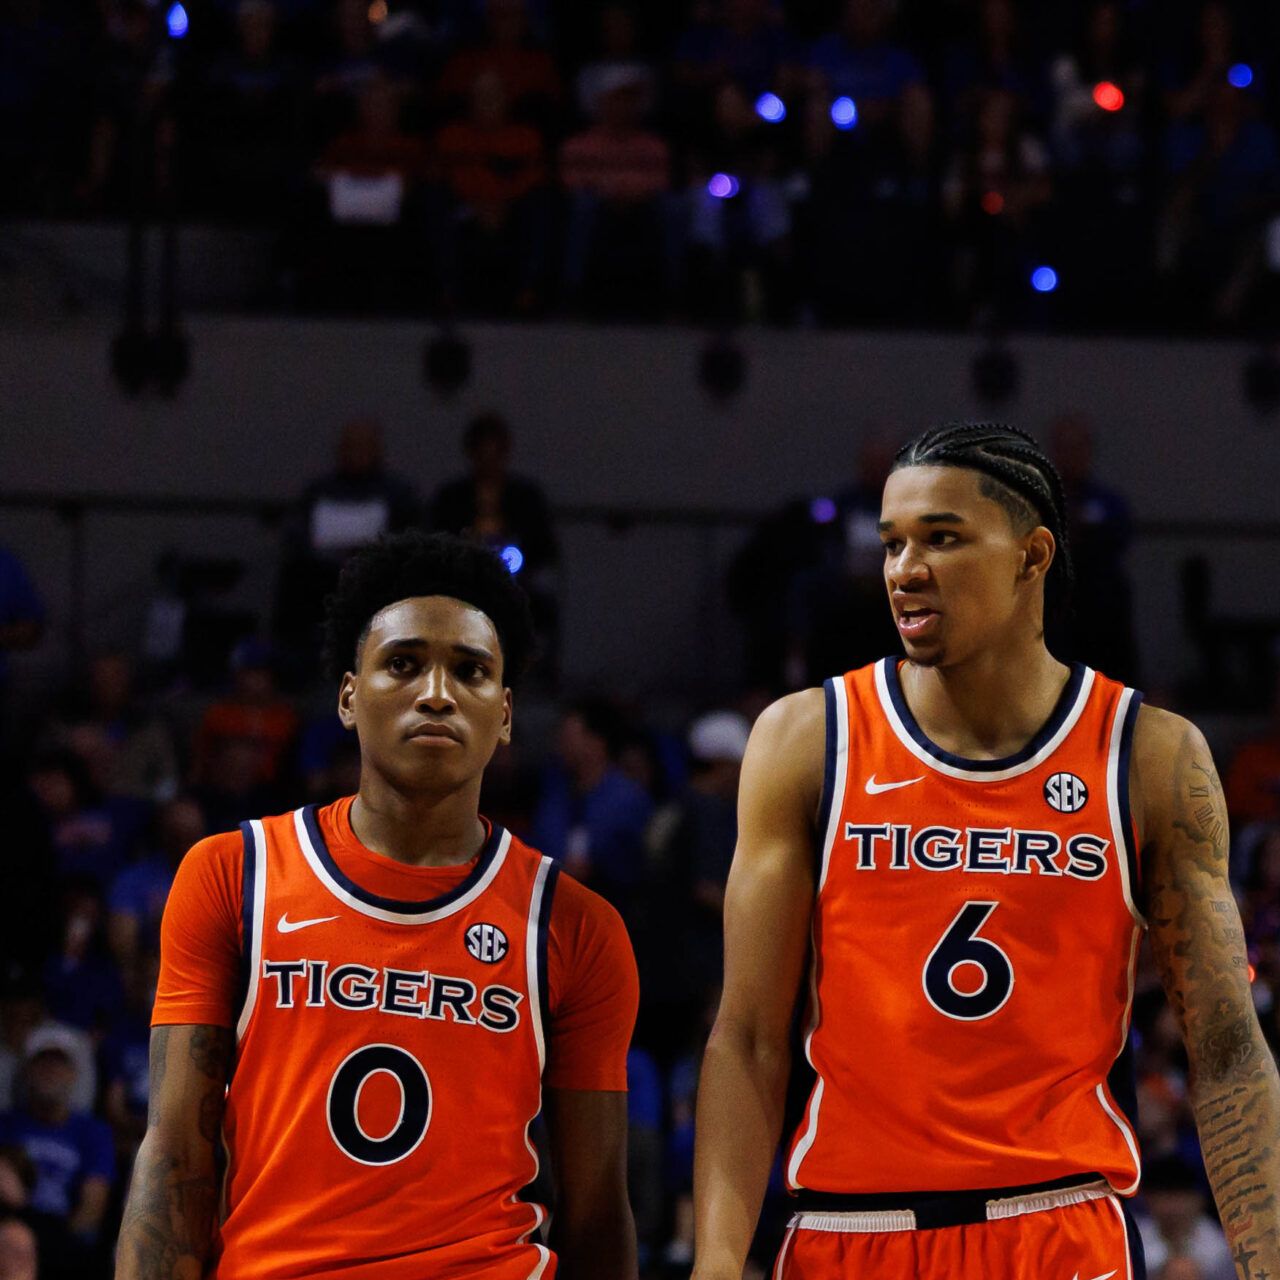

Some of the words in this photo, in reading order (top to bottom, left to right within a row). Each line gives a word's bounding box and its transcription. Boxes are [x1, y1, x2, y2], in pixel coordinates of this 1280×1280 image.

[1045, 772, 1087, 812] SEC
[845, 822, 1111, 881] TIGERS
[466, 923, 507, 963] SEC
[922, 900, 1015, 1021] 6
[263, 959, 525, 1033] TIGERS
[327, 1043, 433, 1166] 0
